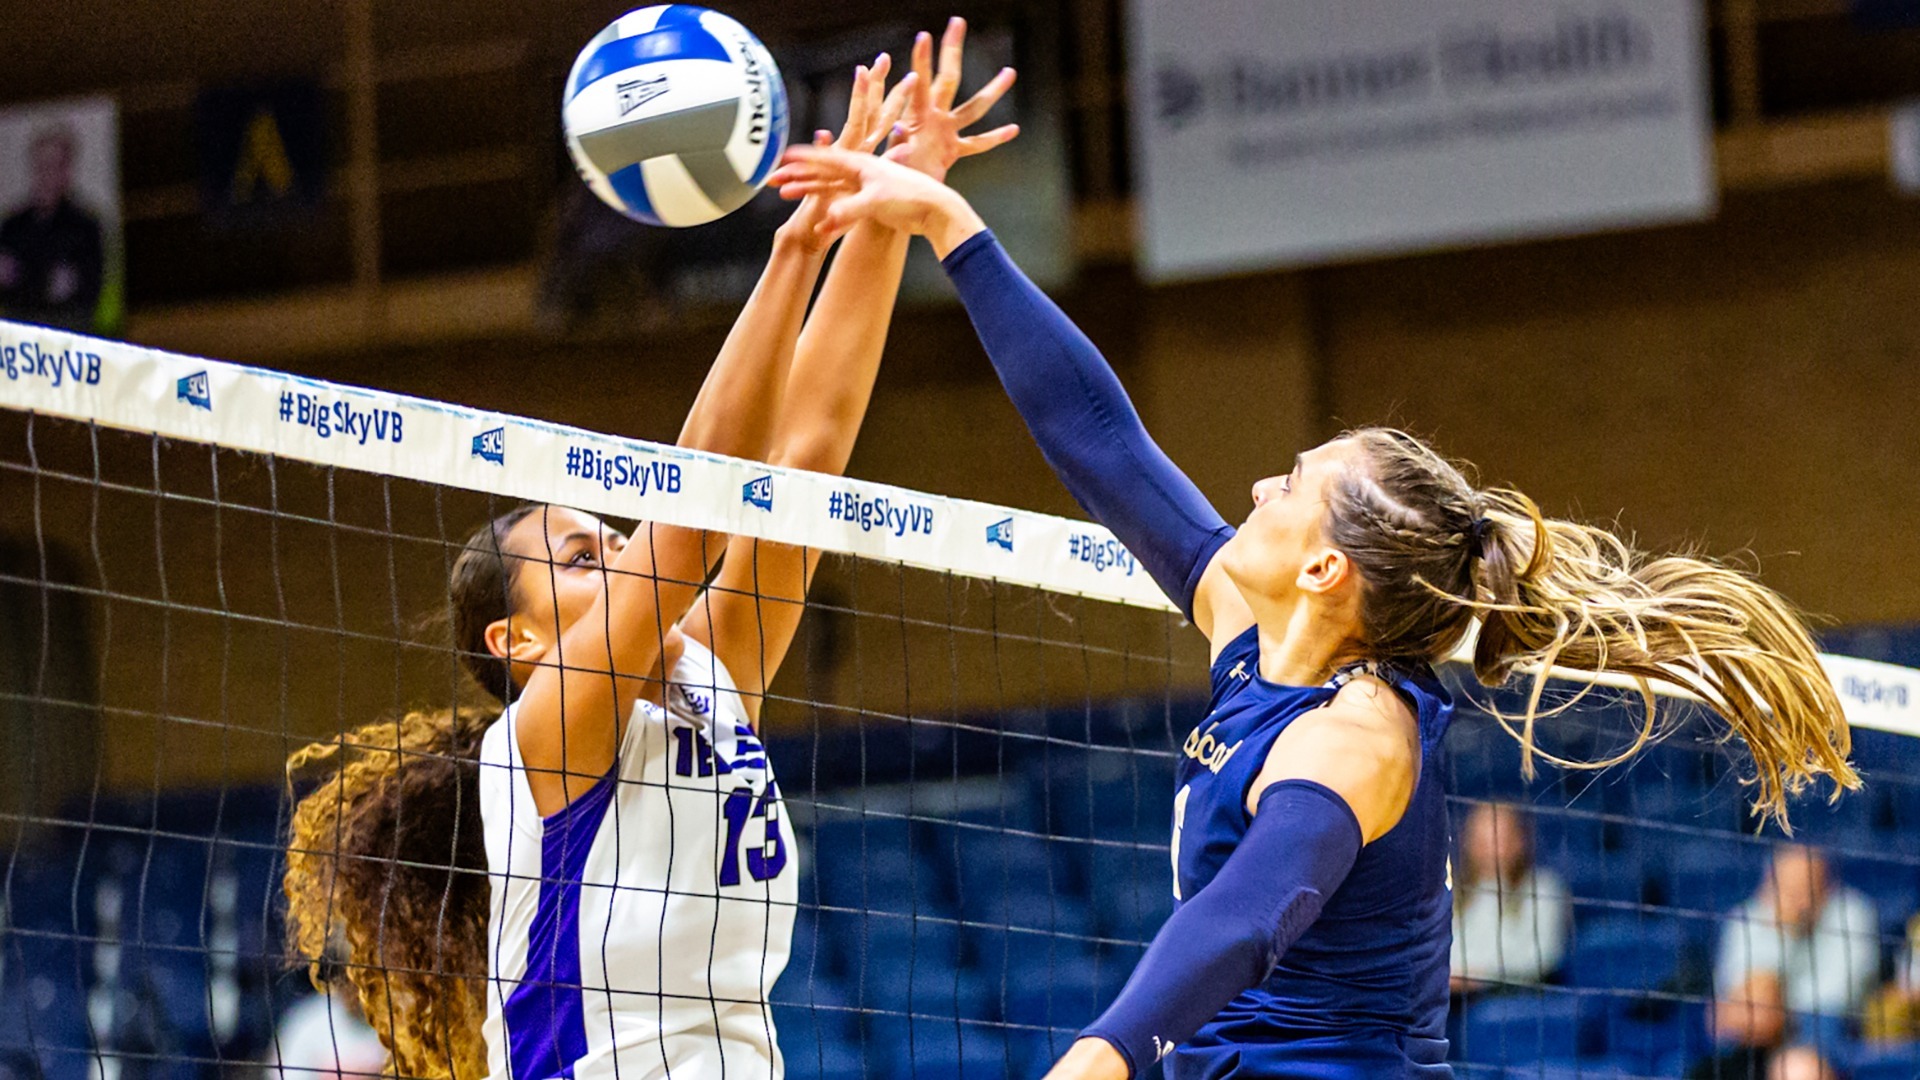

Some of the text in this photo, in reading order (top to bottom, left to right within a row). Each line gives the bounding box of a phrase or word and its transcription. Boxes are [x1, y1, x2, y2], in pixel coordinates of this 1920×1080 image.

[279, 389, 403, 445] #BigSkyVB
[566, 446, 682, 496] #BigSkyVB
[828, 490, 934, 537] #BigSkyVB
[1068, 532, 1147, 577] #BigSky
[718, 780, 788, 888] 13
